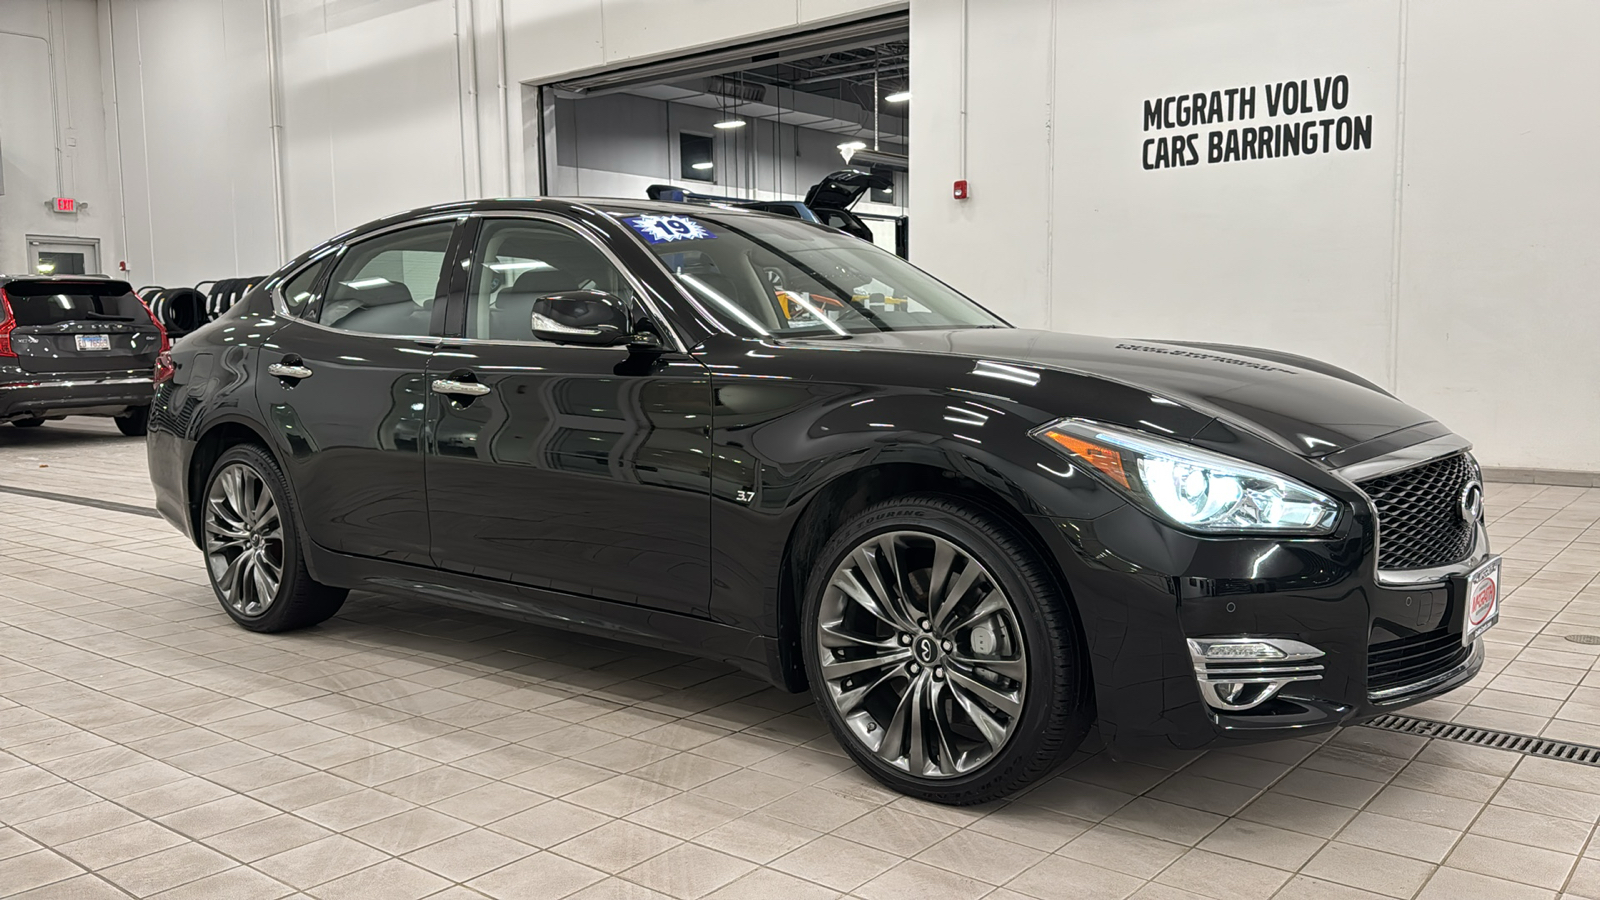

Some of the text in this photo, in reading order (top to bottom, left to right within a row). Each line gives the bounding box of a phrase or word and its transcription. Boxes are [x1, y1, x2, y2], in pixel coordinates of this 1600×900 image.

[1143, 74, 1349, 132] MCGRATH VOLVO
[1142, 114, 1373, 170] CARS BARRINGTON
[57, 198, 74, 211] EXIT
[654, 219, 691, 236] 19
[735, 490, 756, 502] 3.7
[856, 510, 926, 529] TOURING
